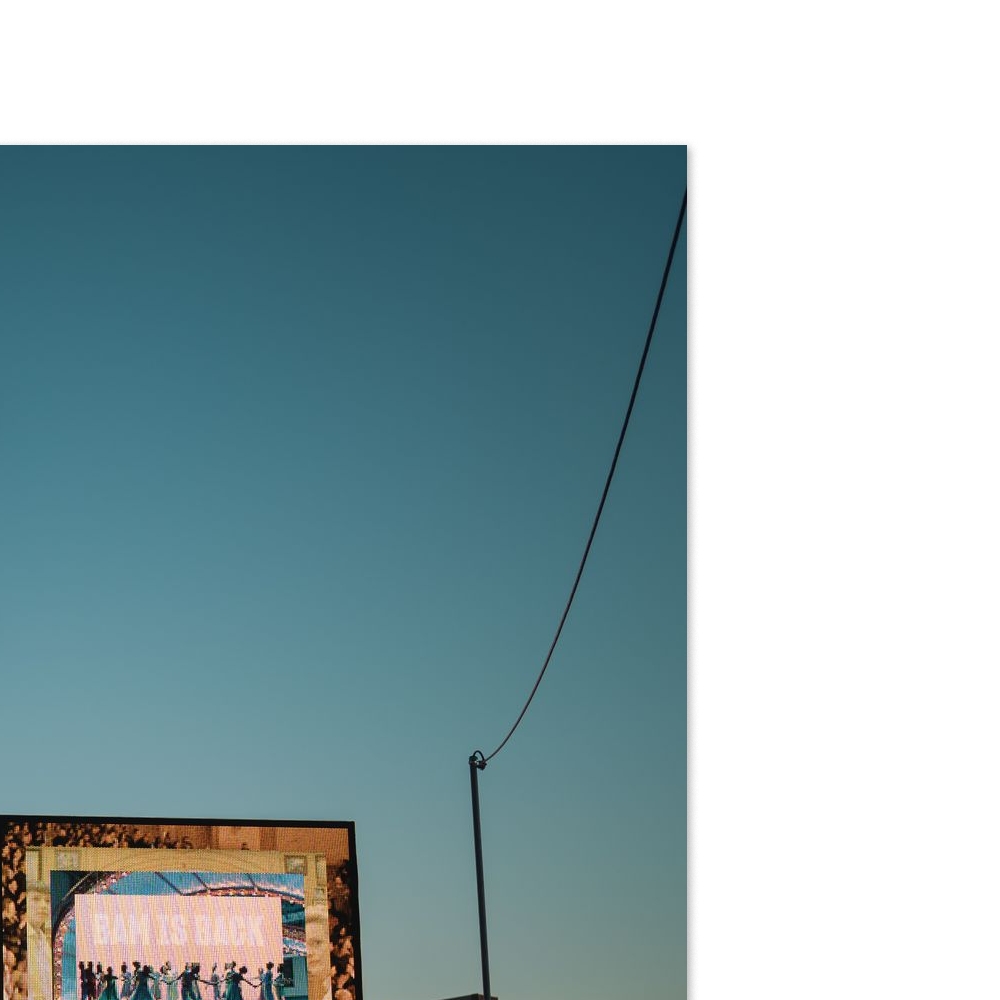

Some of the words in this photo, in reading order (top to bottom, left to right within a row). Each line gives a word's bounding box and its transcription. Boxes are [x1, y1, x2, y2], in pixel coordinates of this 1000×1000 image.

[93, 912, 150, 945] BAM
[157, 914, 188, 946] IS
[194, 914, 265, 947] BACK
